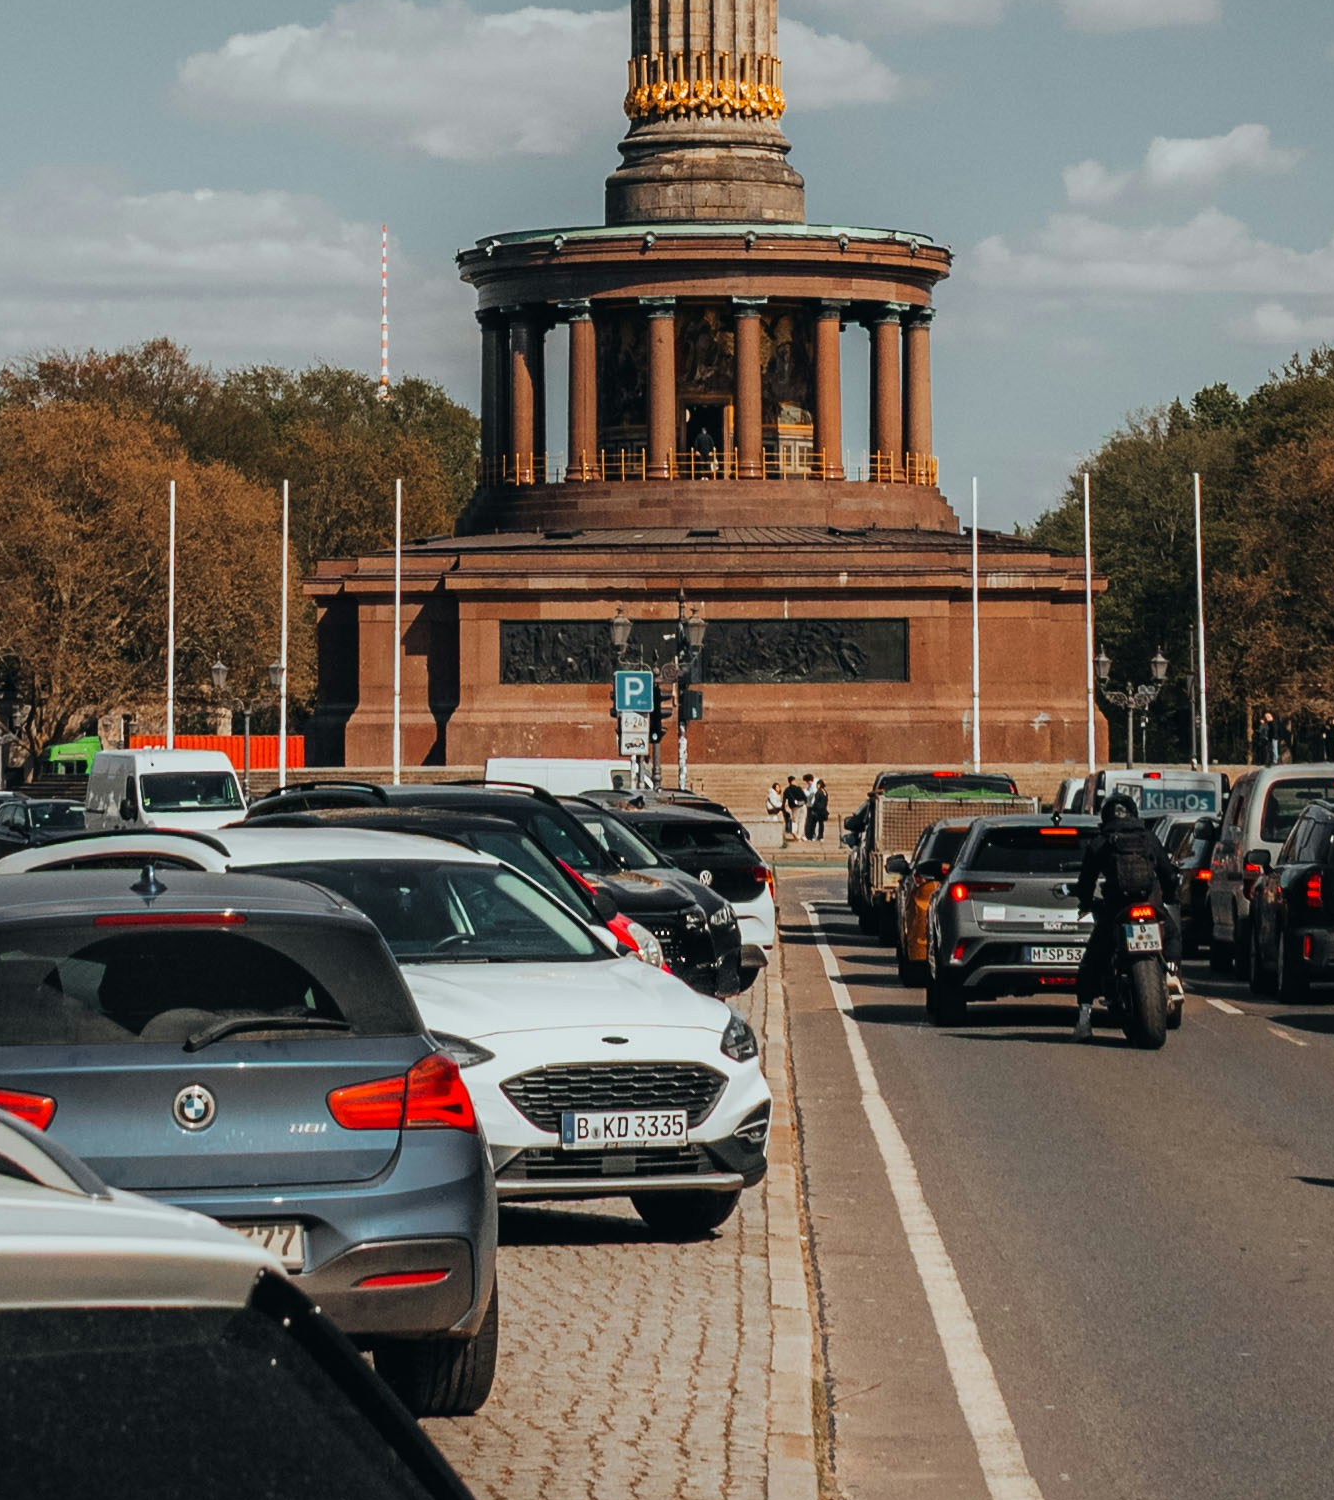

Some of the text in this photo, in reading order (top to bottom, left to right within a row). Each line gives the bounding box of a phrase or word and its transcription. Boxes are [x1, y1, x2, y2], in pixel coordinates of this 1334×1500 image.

[625, 677, 644, 706] P
[1146, 792, 1209, 810] KlarOs
[1033, 949, 1082, 961] M SP 53
[577, 1118, 589, 1139] B
[603, 1116, 629, 1138] KD
[634, 1114, 684, 1137] 3335
